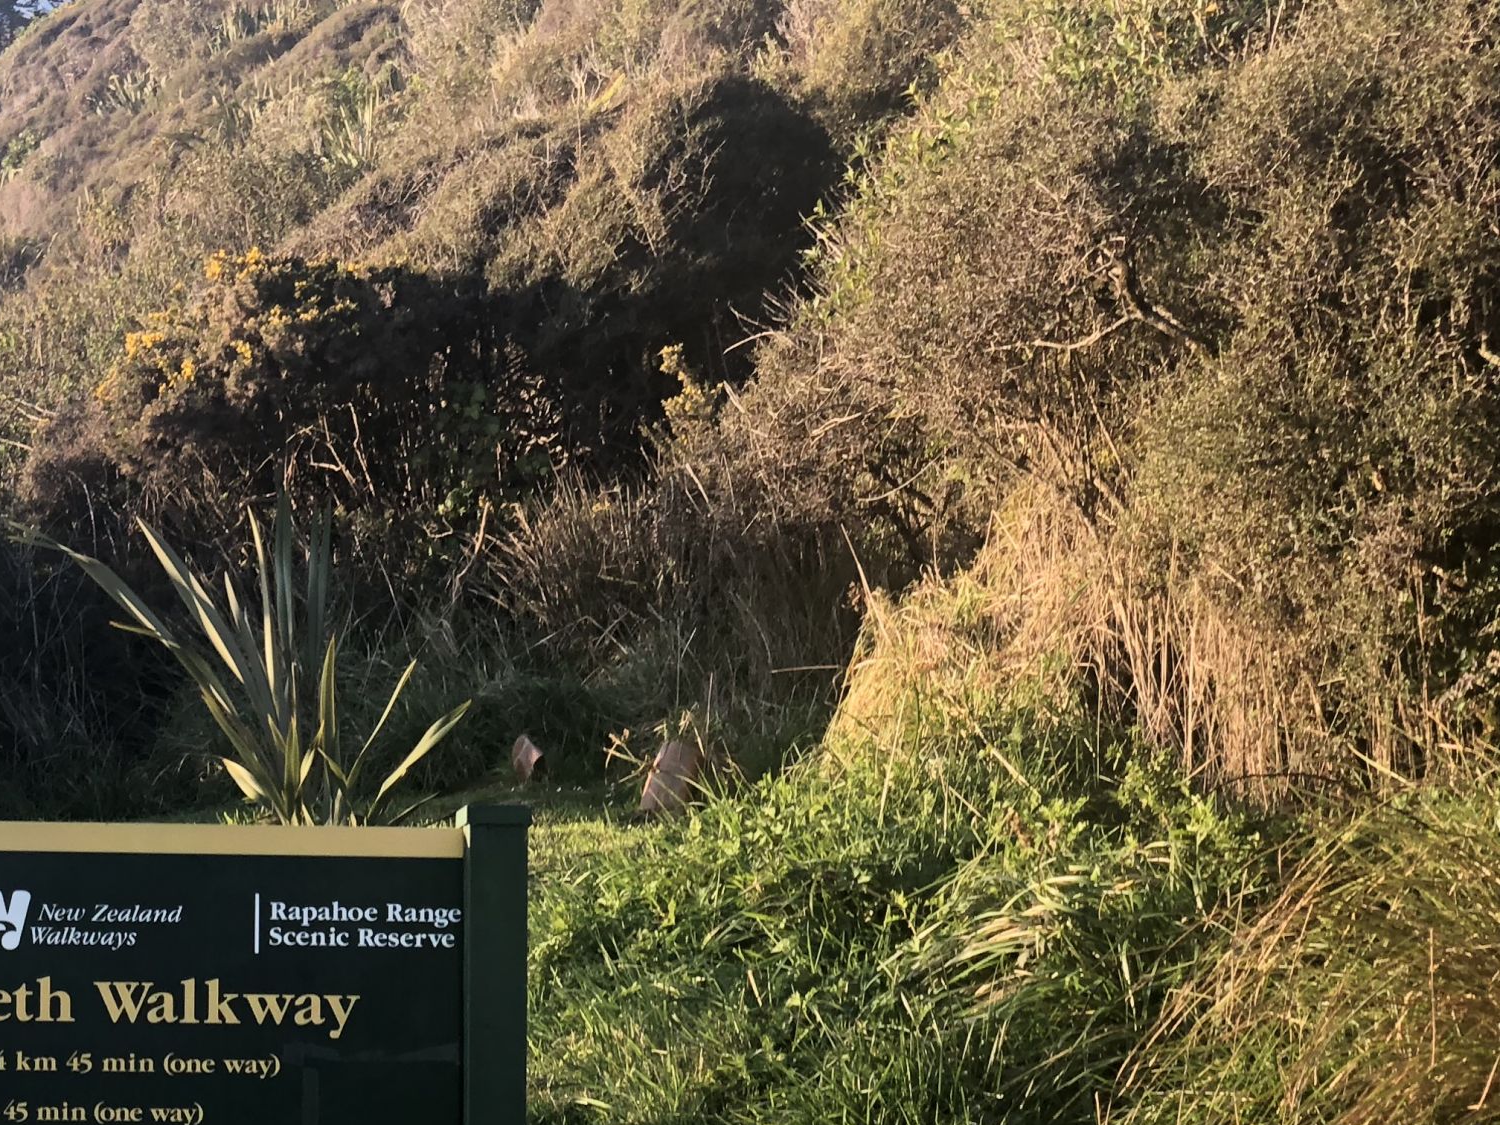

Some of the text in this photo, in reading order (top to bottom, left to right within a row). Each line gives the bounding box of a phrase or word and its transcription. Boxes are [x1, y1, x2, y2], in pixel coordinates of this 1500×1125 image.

[37, 903, 183, 923] New Zealand
[269, 900, 462, 929] Rapahoe Range
[30, 926, 138, 951] Walkways
[268, 926, 455, 948] Scenic Reserve
[93, 977, 361, 1039] Walkway
[16, 1050, 57, 1072] km
[66, 1050, 93, 1074] 45
[102, 1052, 155, 1073] min
[163, 1052, 216, 1076] (one
[223, 1053, 281, 1080] way)
[3, 1099, 29, 1123] 45
[36, 1101, 87, 1121] min
[93, 1101, 143, 1124] (one
